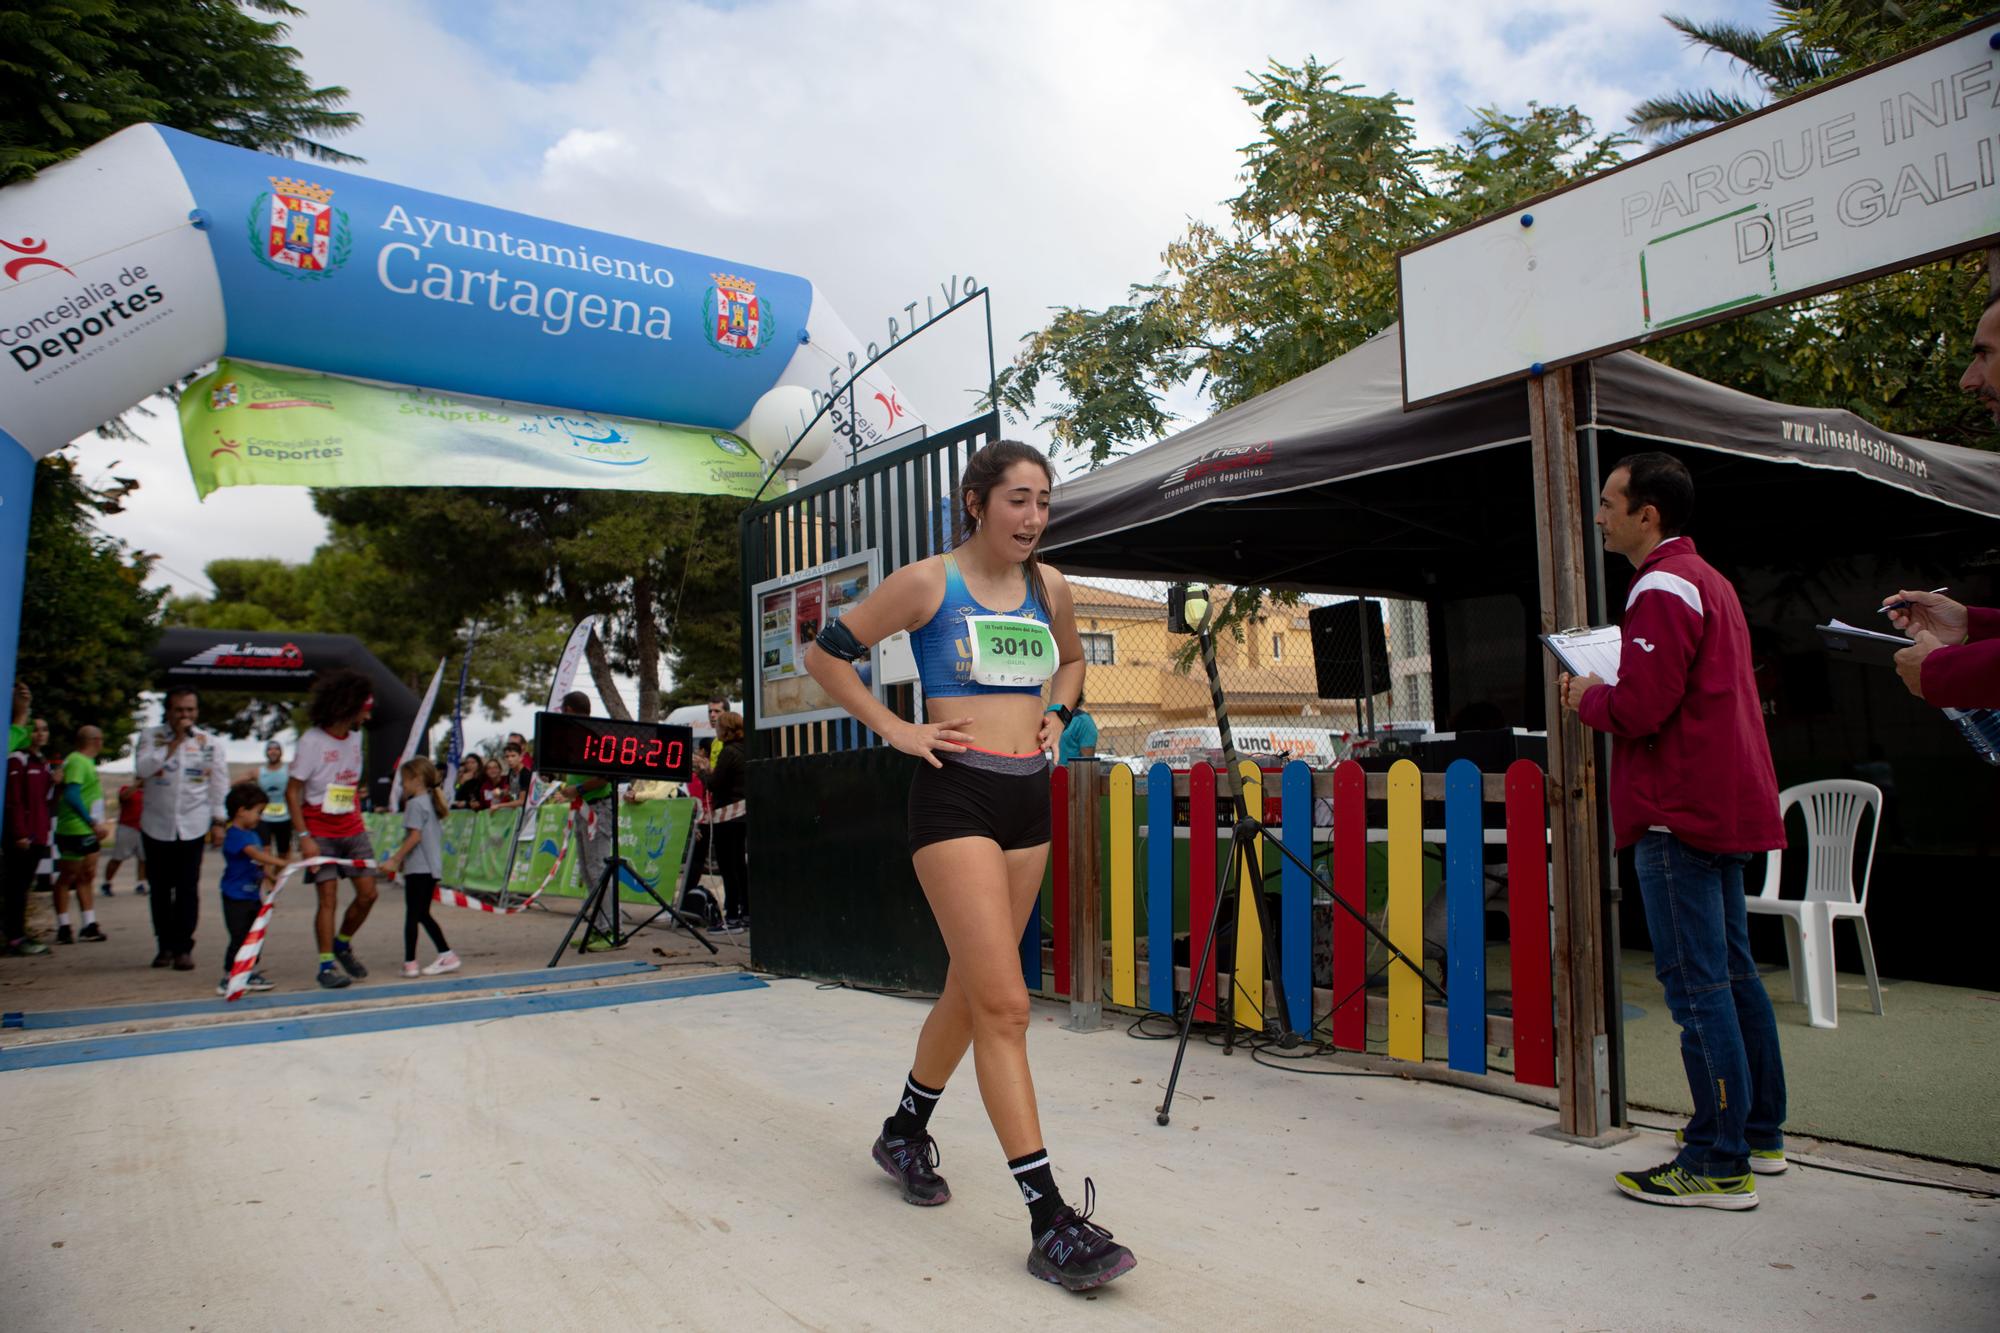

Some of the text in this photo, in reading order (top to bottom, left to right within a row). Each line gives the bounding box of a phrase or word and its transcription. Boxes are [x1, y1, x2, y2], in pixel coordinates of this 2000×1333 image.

[1621, 60, 2000, 237] PARQUE INF
[1735, 134, 2000, 264] DE GALI
[380, 204, 675, 289] Ayuntamiento
[118, 265, 149, 288] de
[377, 242, 672, 341] Cartagena
[9, 284, 164, 372] Deportes
[247, 445, 344, 461] Deportes
[1164, 468, 1264, 500] cronometrajes deportivos
[991, 637, 1043, 657] 3010
[584, 735, 683, 769] 1:08:20
